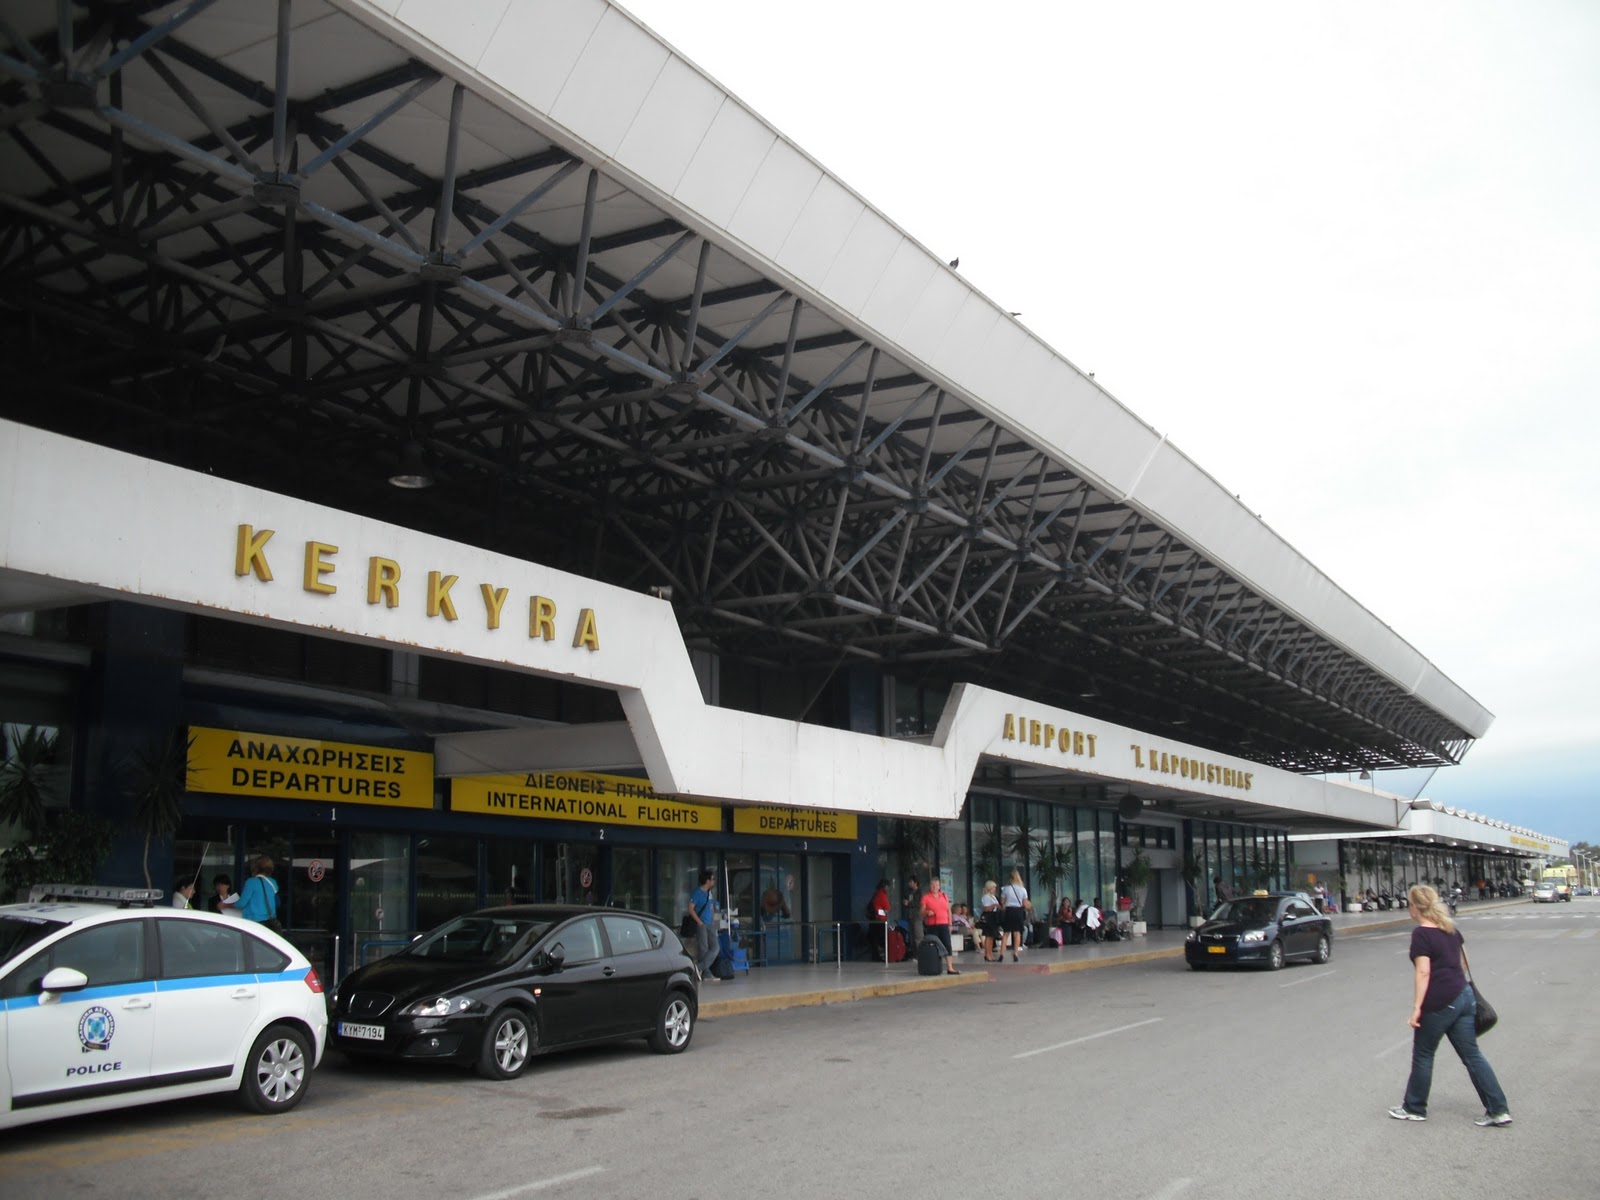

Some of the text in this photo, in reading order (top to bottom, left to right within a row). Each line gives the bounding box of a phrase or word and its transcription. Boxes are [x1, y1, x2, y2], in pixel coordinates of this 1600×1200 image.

[235, 524, 600, 652] KERKYRA
[1002, 713, 1097, 758] AIRPORT
[226, 739, 405, 774] ΑΝΑΧΩΡΗΣΕΙΣ
[232, 768, 401, 799] DEPARTURES
[525, 773, 605, 795] ΔΙΕΘΝΕΙΣ
[331, 808, 337, 821] 1
[487, 791, 699, 824] INTERNATIONAL FLIGHTS
[599, 829, 605, 840] 2
[760, 816, 837, 833] DEPARTURES
[66, 1061, 122, 1077] POLICE
